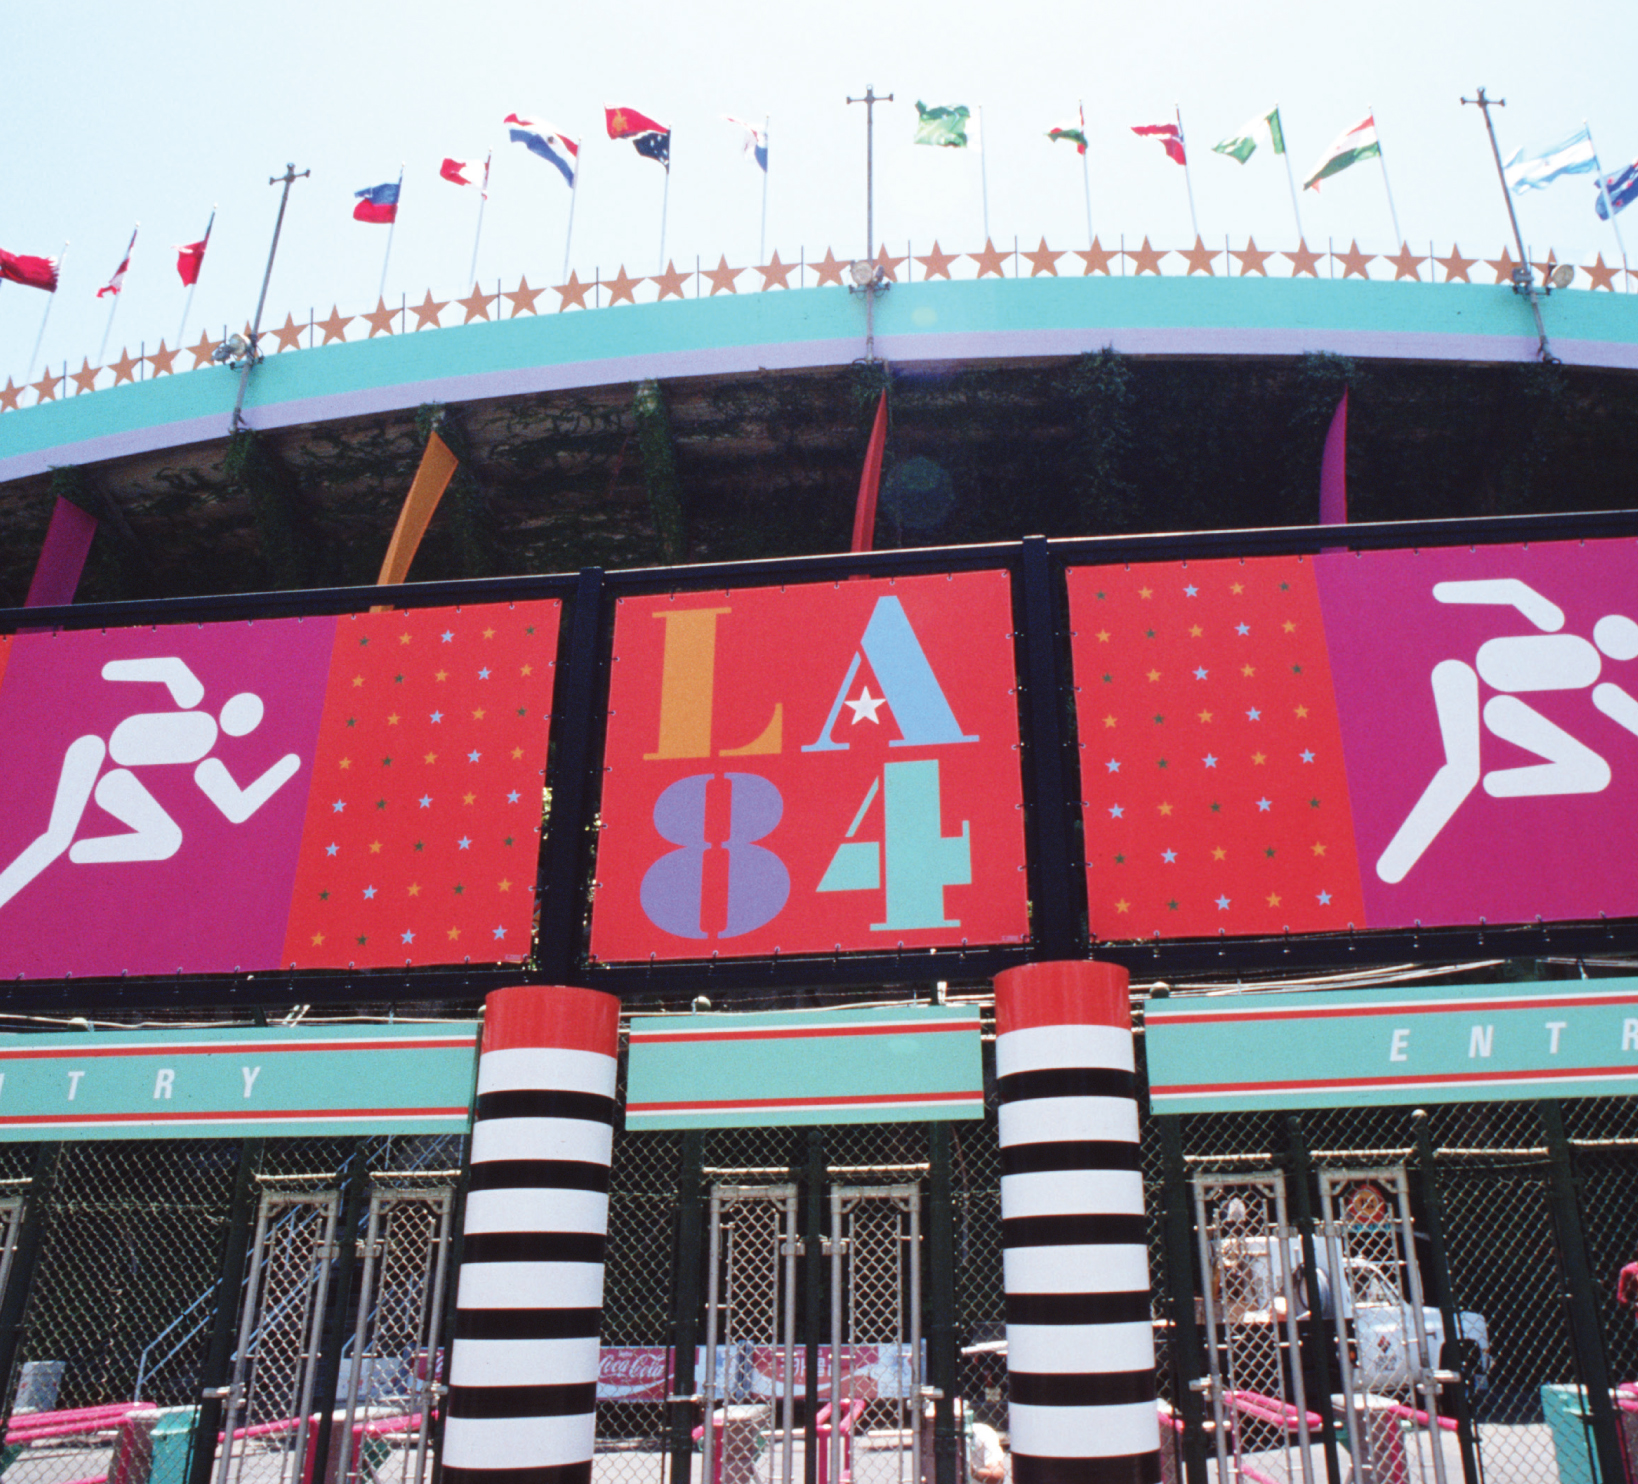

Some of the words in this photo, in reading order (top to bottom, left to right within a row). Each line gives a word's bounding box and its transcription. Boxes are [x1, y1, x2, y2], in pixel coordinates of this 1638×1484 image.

[643, 595, 980, 761] LA
[639, 759, 973, 940] 84
[0, 1067, 260, 1101] TRY
